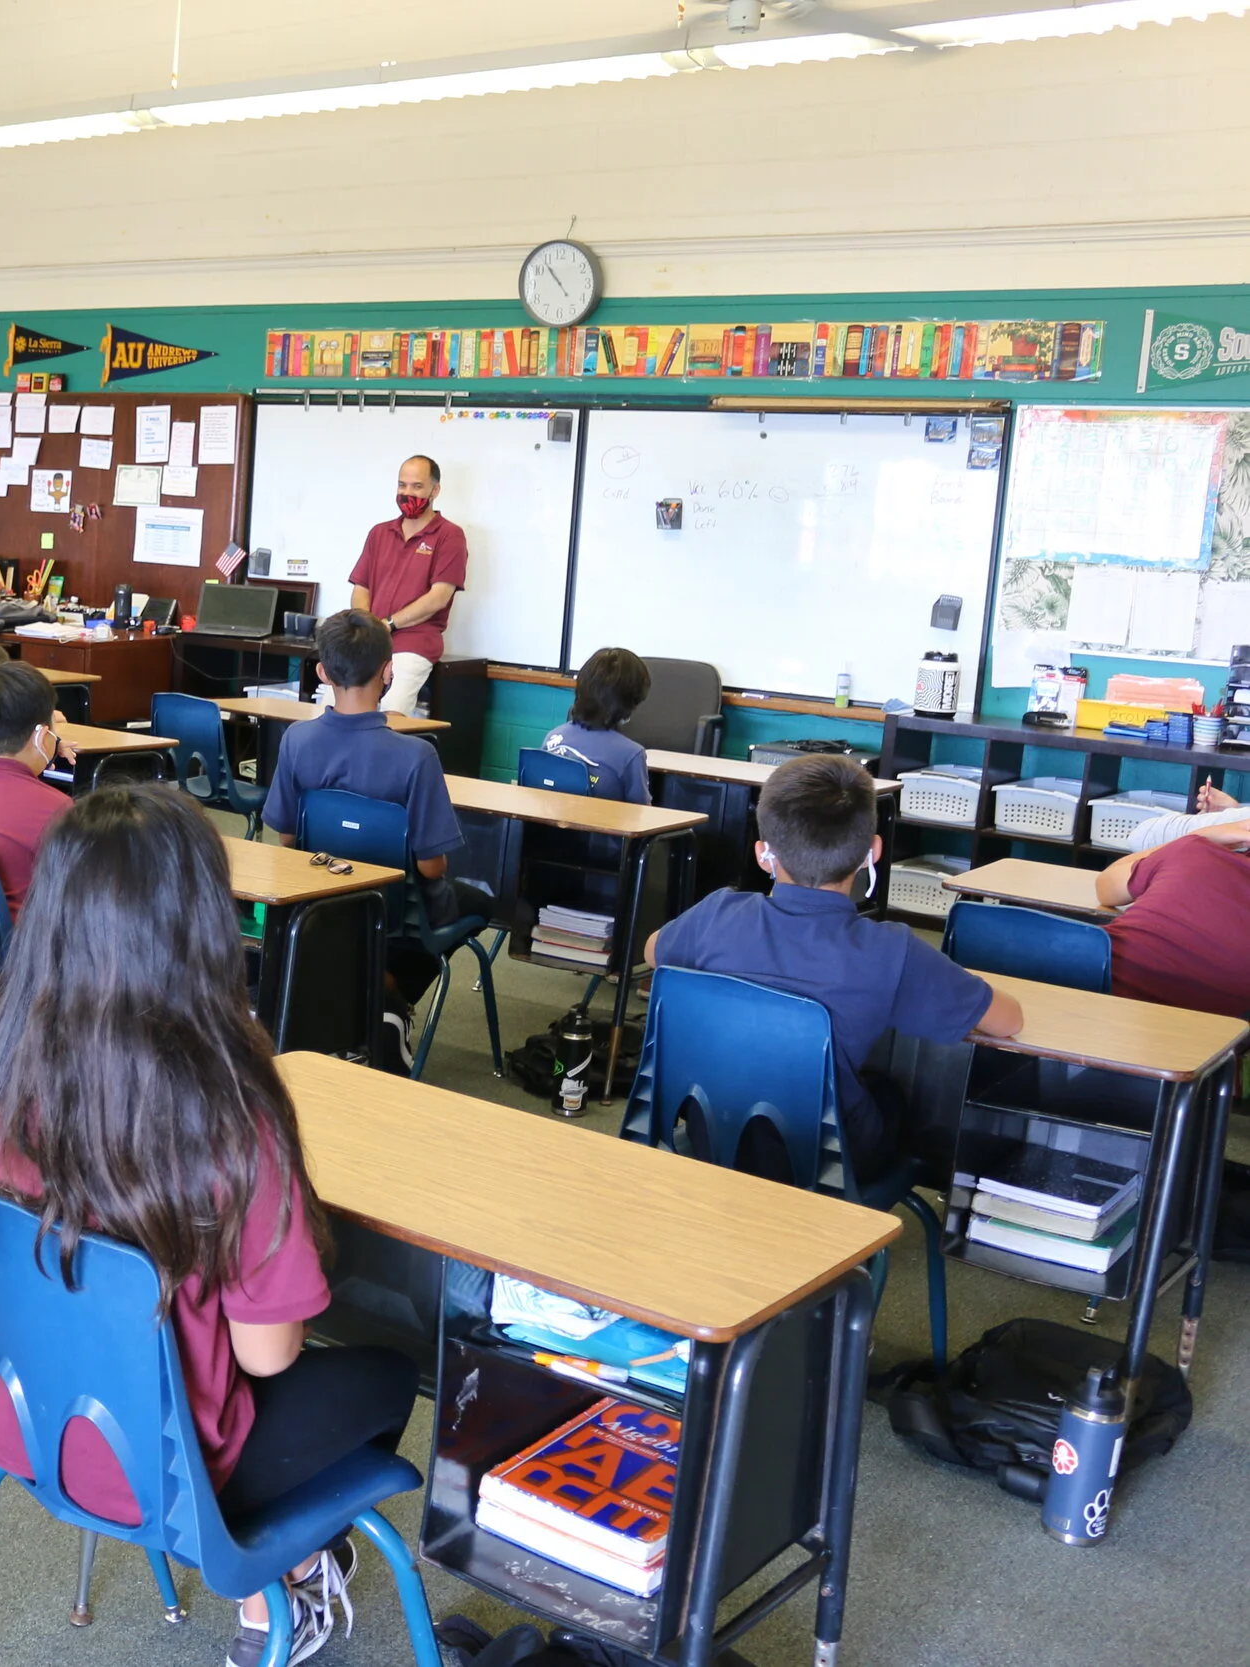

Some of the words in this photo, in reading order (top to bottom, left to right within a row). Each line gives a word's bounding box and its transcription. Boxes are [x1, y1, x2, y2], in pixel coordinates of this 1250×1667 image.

[556, 248, 566, 260] 12
[579, 263, 587, 274] 2
[584, 278, 591, 290] 3
[533, 293, 541, 305] 8
[579, 292, 586, 305] 4
[543, 303, 550, 315] 7
[556, 307, 563, 319] 6
[569, 303, 576, 315] 5
[28, 337, 39, 348] La
[39, 337, 62, 350] Sierra
[112, 342, 146, 369] AU
[147, 343, 198, 357] ANDREWS
[1174, 343, 1190, 360] S
[147, 355, 197, 369] UNIVERSITY
[1215, 364, 1250, 376] ADVENT
[598, 1421, 679, 1454] Algebr
[619, 1498, 662, 1520] SAXON
